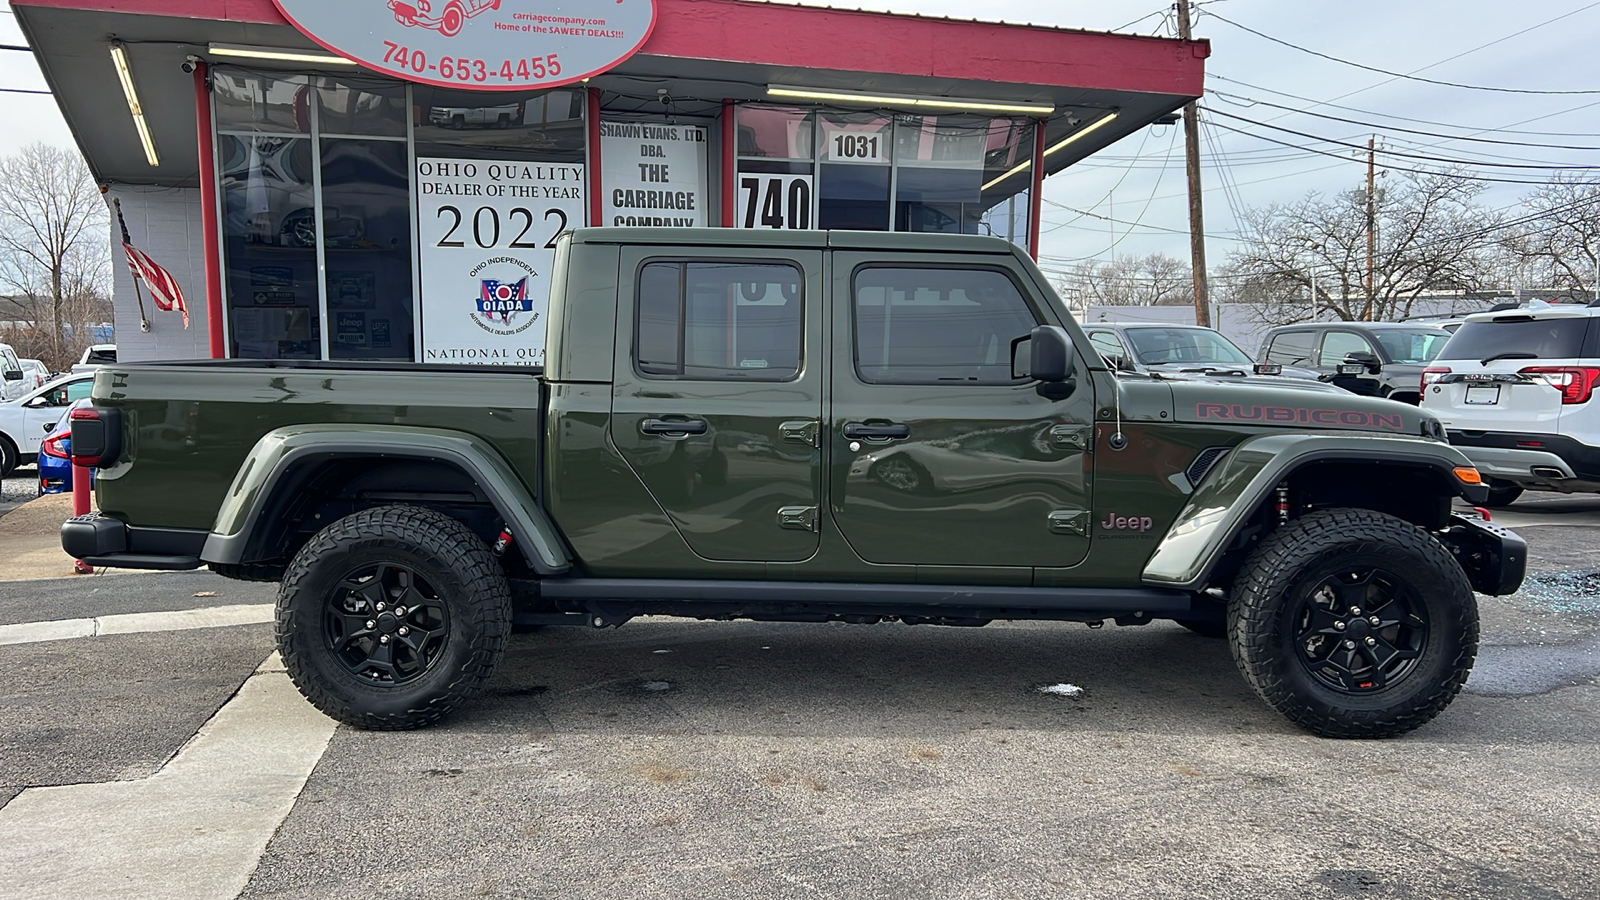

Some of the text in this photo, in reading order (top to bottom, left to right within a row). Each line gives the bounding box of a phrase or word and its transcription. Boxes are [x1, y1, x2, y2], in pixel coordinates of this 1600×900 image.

[512, 12, 606, 26] carriagecompany.com
[494, 22, 624, 38] Home of the SAWEET DEALS!!!
[382, 40, 562, 82] 740-653-4455
[600, 123, 705, 142] SHAWN EVANS. LTD.
[640, 144, 666, 158] DBA.
[834, 135, 878, 158] 1031
[419, 162, 582, 181] OHIO QUALITY
[638, 163, 669, 183] THE
[422, 182, 581, 199] DEALER OF THE YEAR
[612, 188, 695, 210] CARRIAGE
[741, 177, 810, 229] 740
[436, 205, 568, 249] 2022
[469, 256, 539, 277] OHIO INDEPENDENT
[482, 300, 524, 311] OIADA
[469, 312, 494, 334] AUTOMOBILE
[515, 312, 540, 334] ASSOCIATION
[427, 348, 510, 358] NATIONAL
[1196, 402, 1403, 429] RUBICON
[1101, 512, 1153, 532] Jeep
